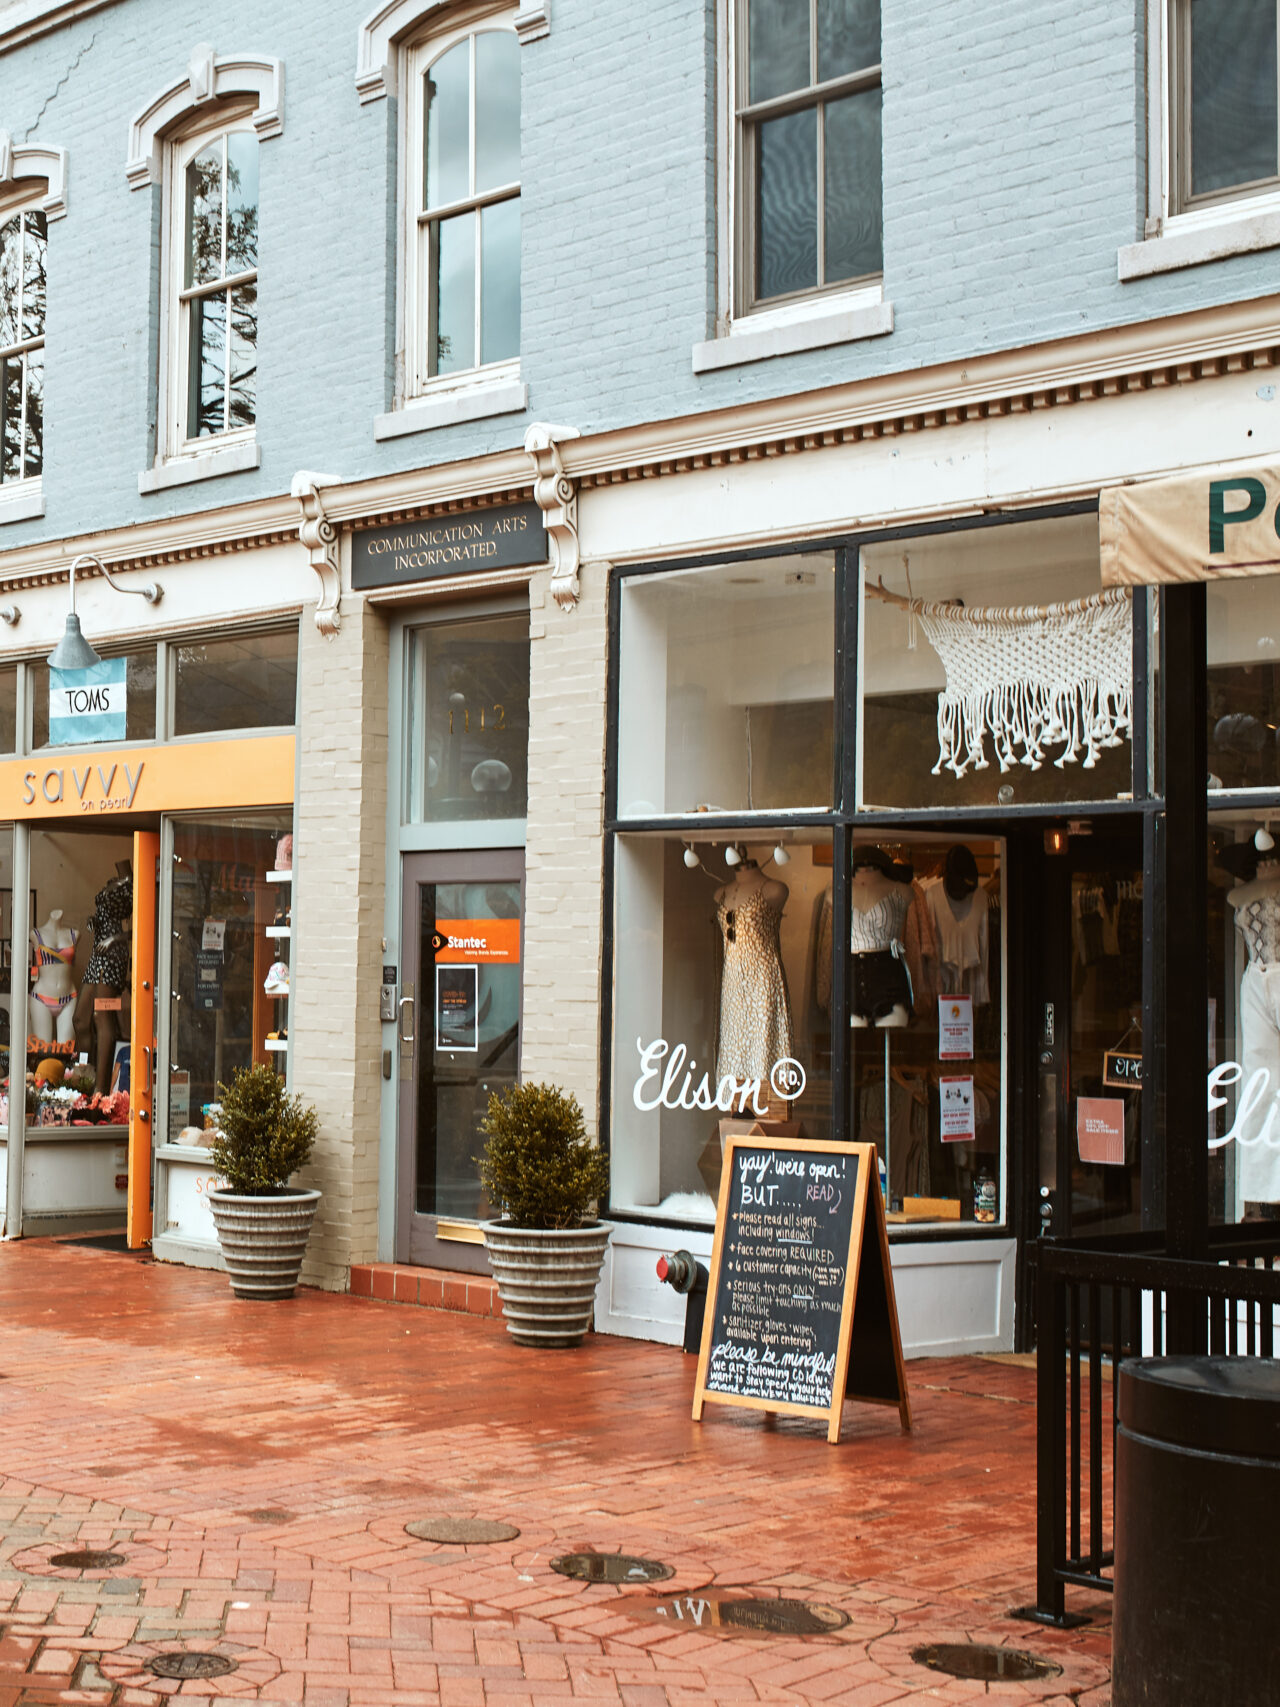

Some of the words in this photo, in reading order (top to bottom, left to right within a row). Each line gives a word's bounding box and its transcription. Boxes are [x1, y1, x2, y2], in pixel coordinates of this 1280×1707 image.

[1209, 476, 1280, 555] P
[367, 522, 483, 555] COMMUNICATION
[492, 515, 528, 535] ARTS
[394, 541, 498, 570] INCORPORATED.
[64, 688, 110, 714] TOMS
[448, 703, 505, 735] 1112
[22, 761, 145, 809] savvy
[81, 800, 94, 811] on
[99, 796, 128, 811] pearl
[447, 935, 487, 948] Stantec
[26, 1033, 76, 1054] Spring
[632, 1036, 769, 1116] Elison
[806, 1184, 834, 1202] READ
[764, 1213, 782, 1226] read
[784, 1213, 794, 1228] all
[738, 1224, 773, 1242] including
[737, 1242, 754, 1256] face
[756, 1244, 788, 1262] covering
[790, 1245, 835, 1265] REQUIRED
[743, 1260, 778, 1274] customer
[733, 1279, 761, 1293] serious
[732, 1302, 740, 1312] as
[741, 1304, 770, 1318] possible
[756, 1293, 773, 1306] limit
[775, 1296, 808, 1313] touching
[810, 1301, 819, 1311] as
[821, 1302, 841, 1313] much
[726, 1326, 757, 1341] available
[761, 1332, 779, 1346] upon
[765, 1318, 787, 1334] gloves
[711, 1340, 760, 1364] please
[761, 1345, 780, 1365] be
[781, 1348, 836, 1376] mindful
[728, 1361, 745, 1374] are
[747, 1362, 790, 1384] following
[734, 1372, 743, 1384] to
